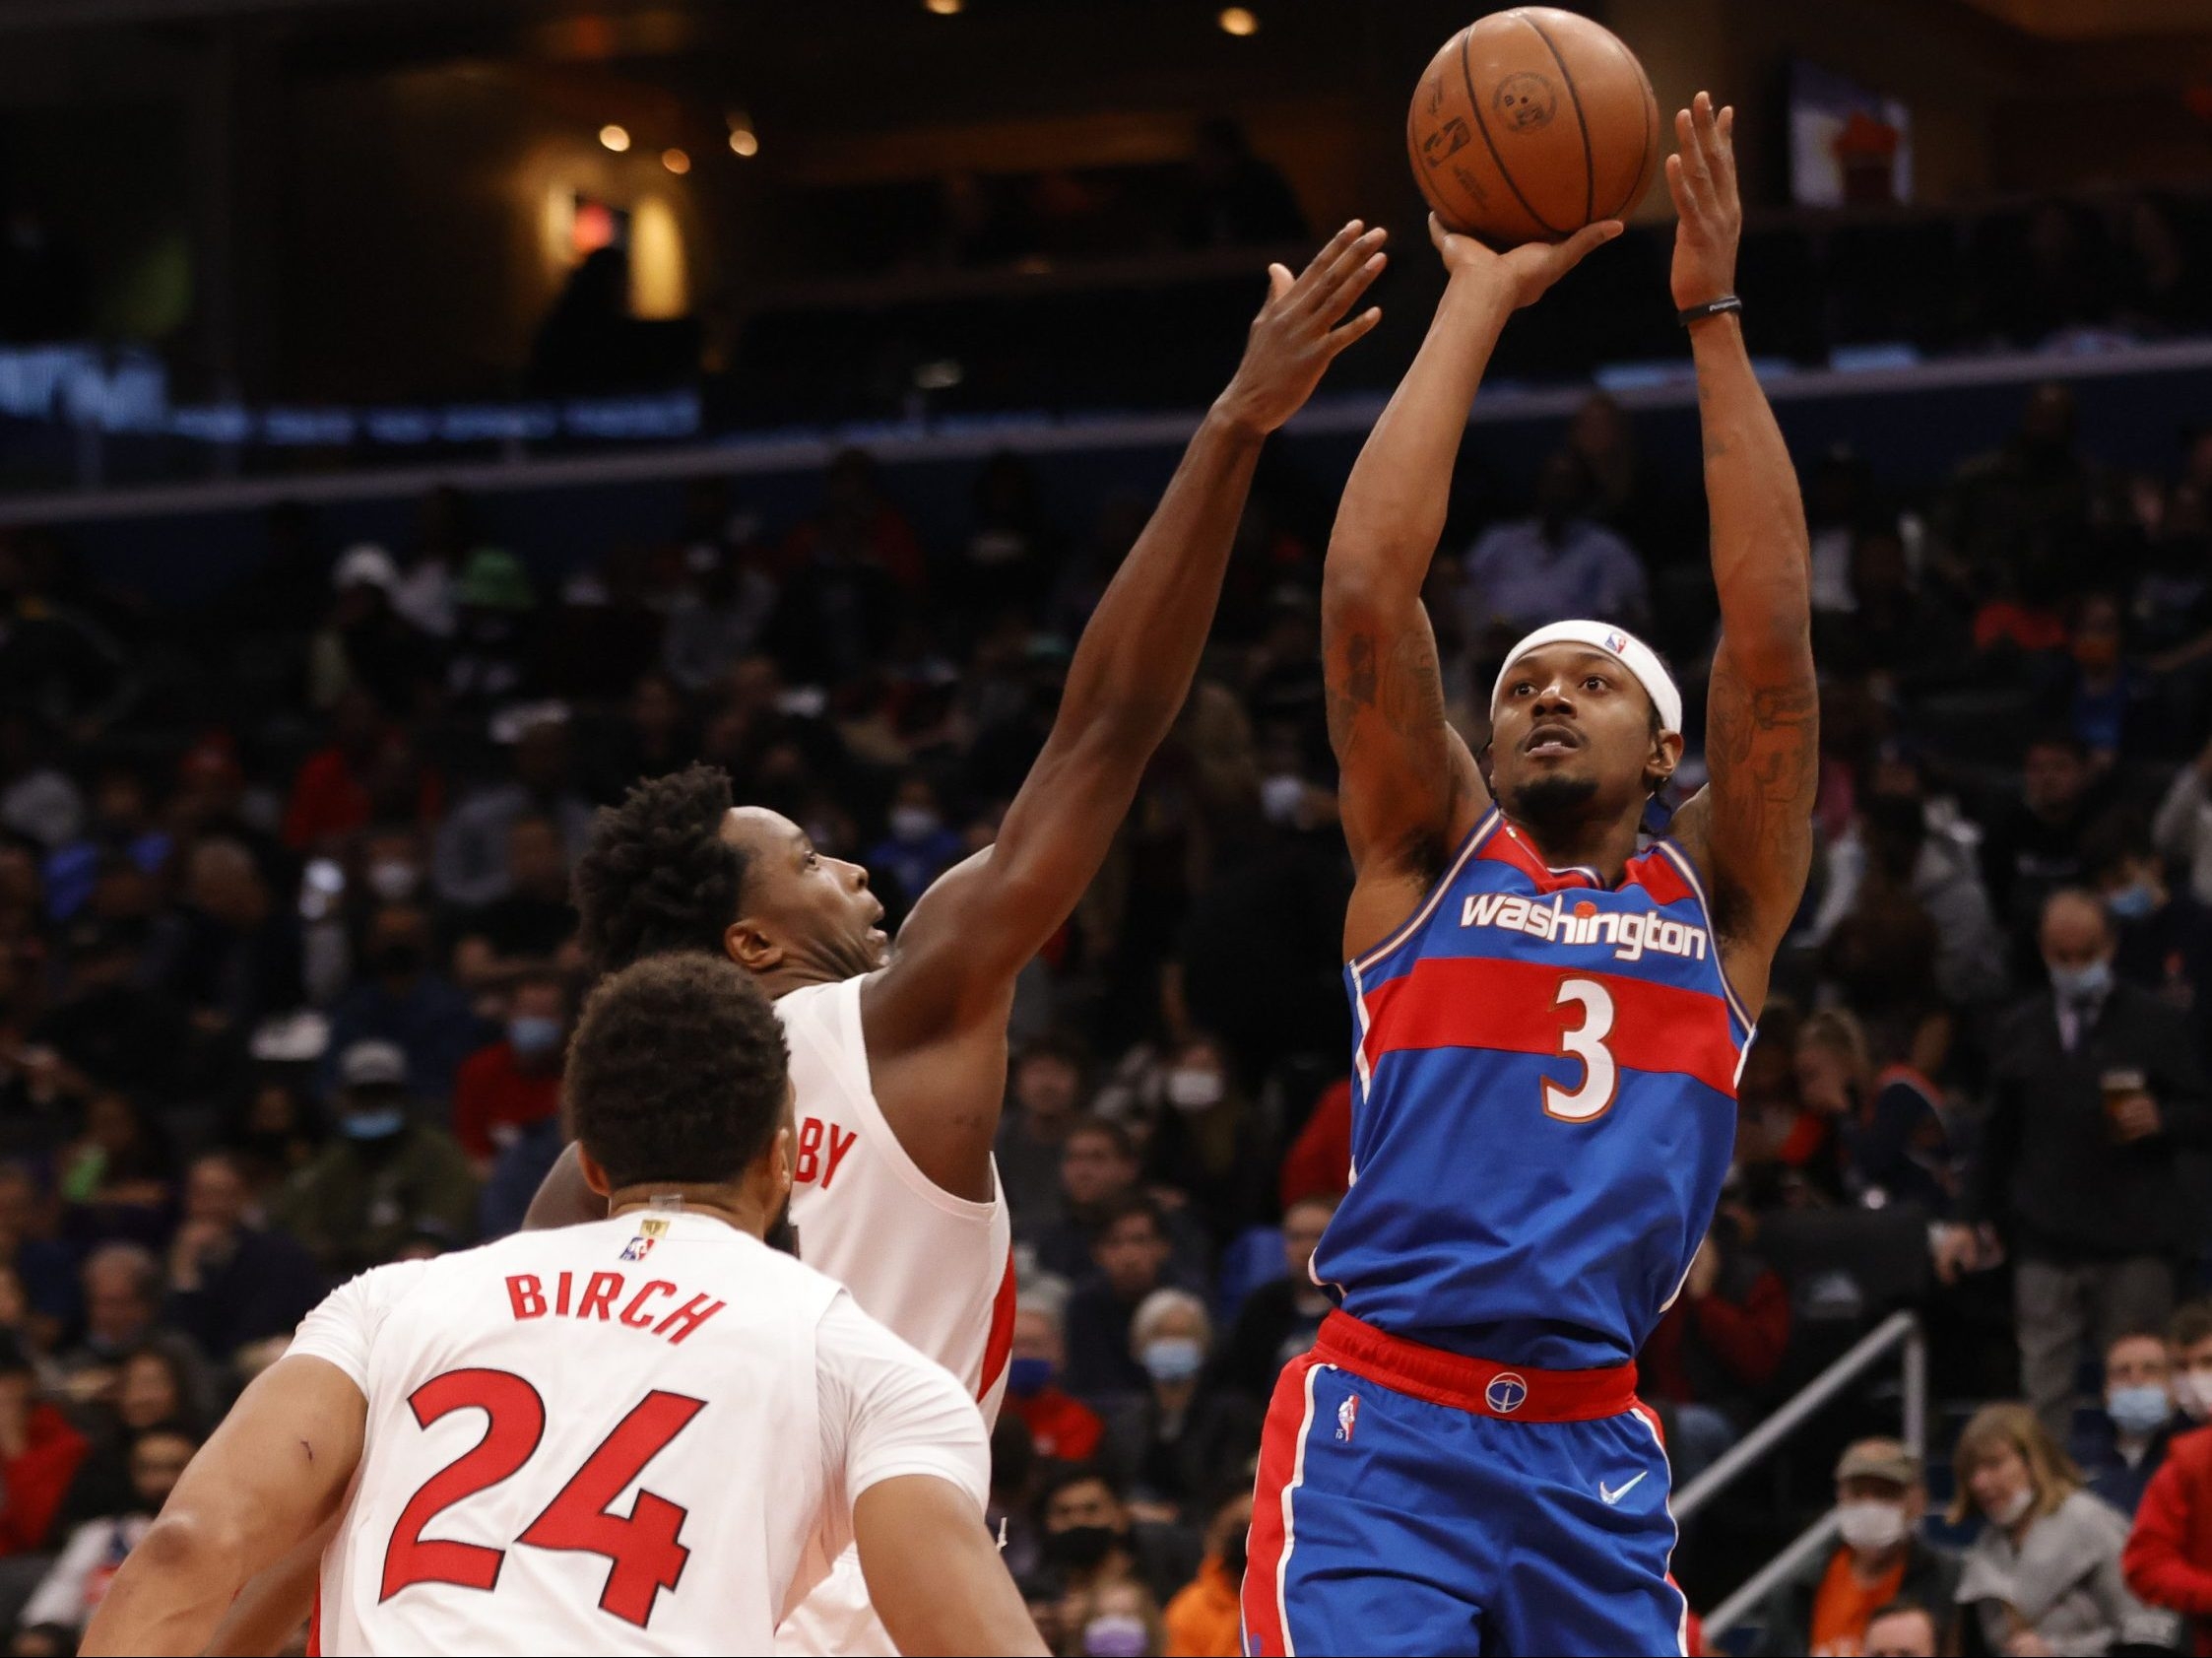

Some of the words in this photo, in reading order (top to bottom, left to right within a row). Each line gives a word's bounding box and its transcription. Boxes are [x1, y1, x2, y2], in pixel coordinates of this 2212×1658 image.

[1460, 894, 1708, 962] washington
[1540, 972, 1621, 1124] 3
[504, 1272, 727, 1346] BIRCH
[378, 1367, 709, 1631] 24
